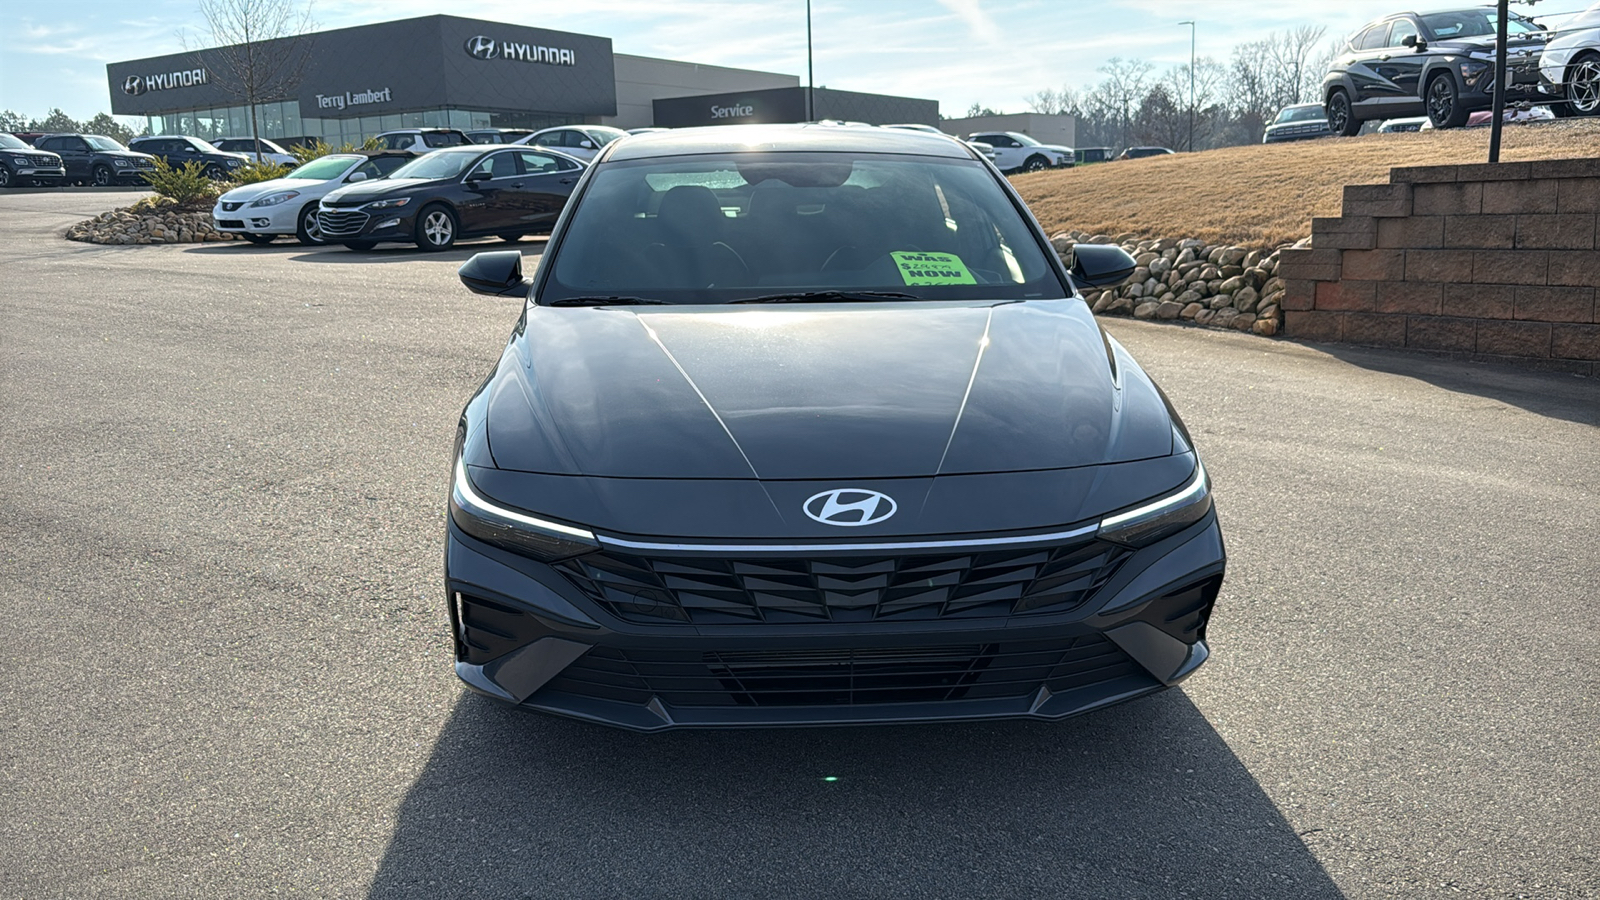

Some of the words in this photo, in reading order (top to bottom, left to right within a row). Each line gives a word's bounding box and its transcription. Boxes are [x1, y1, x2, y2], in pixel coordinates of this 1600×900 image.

[503, 42, 575, 66] HYUNDAI
[146, 68, 206, 91] HYUNDAI
[315, 94, 345, 110] Terry
[346, 87, 392, 106] Lambert
[711, 103, 753, 119] Service
